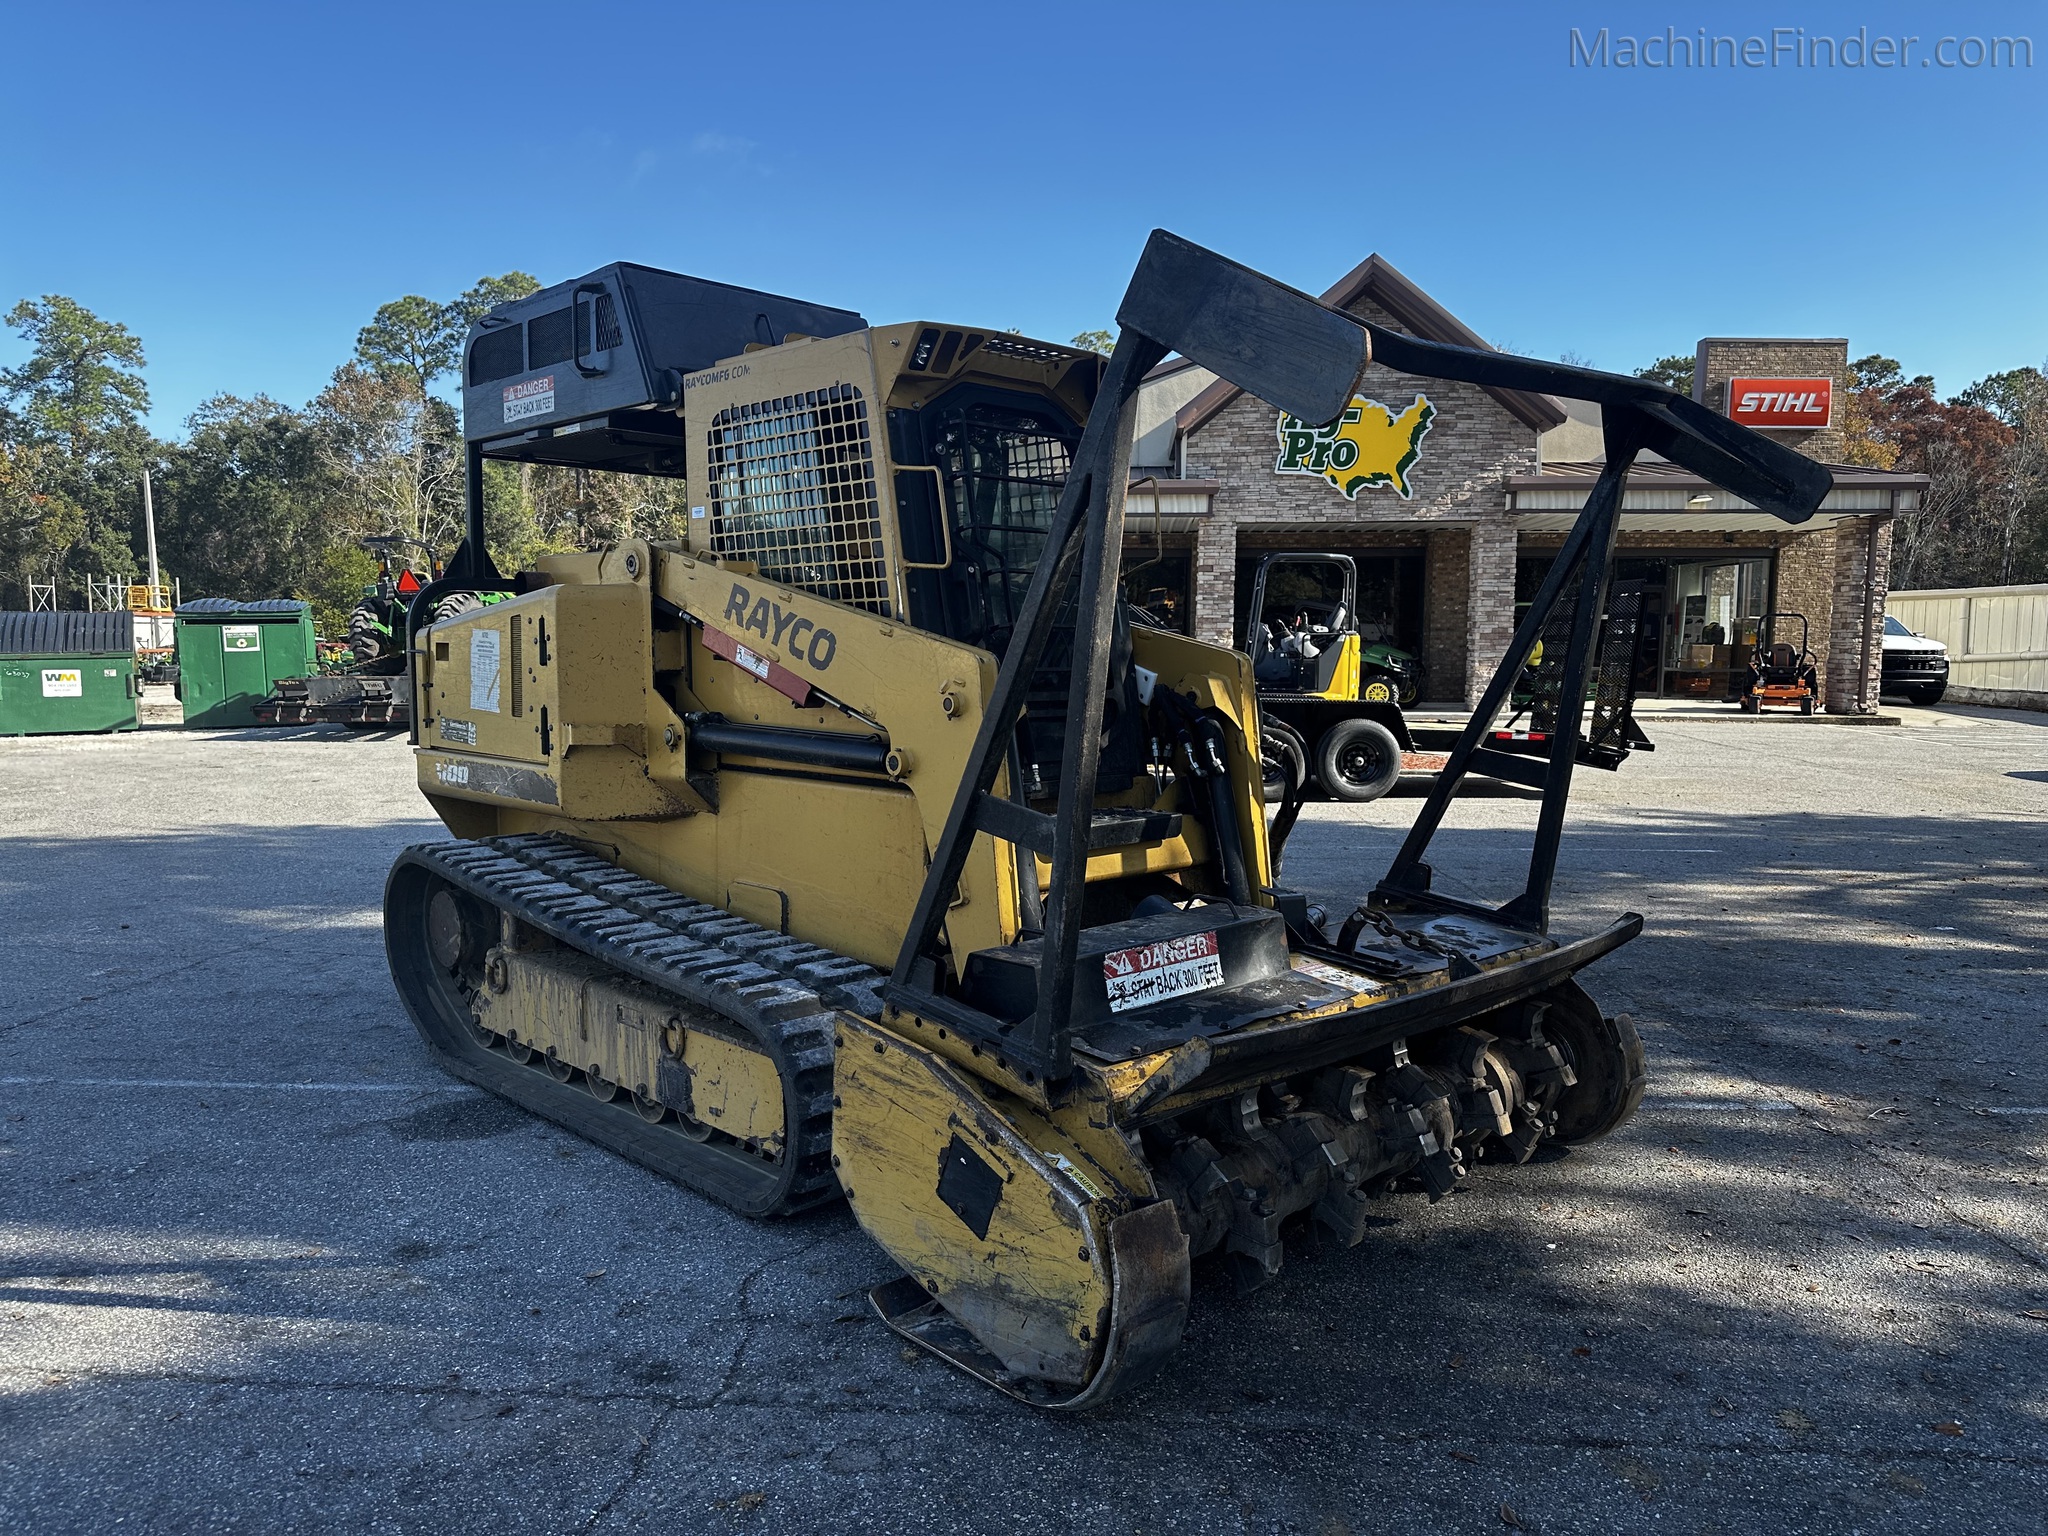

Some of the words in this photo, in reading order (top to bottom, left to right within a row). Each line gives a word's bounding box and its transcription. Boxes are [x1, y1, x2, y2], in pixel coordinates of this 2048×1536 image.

[517, 378, 549, 398] DANGER
[523, 400, 536, 415] BACK
[542, 396, 553, 410] FEET
[1736, 392, 1824, 413] STIHL
[1279, 430, 1360, 471] Pro
[724, 582, 837, 671] RAYCO
[45, 673, 77, 682] WM
[1139, 936, 1208, 969] DANGER
[1155, 968, 1183, 994] BACK
[1182, 967, 1199, 988] 300
[1074, 1172, 1101, 1197] CAUTION
